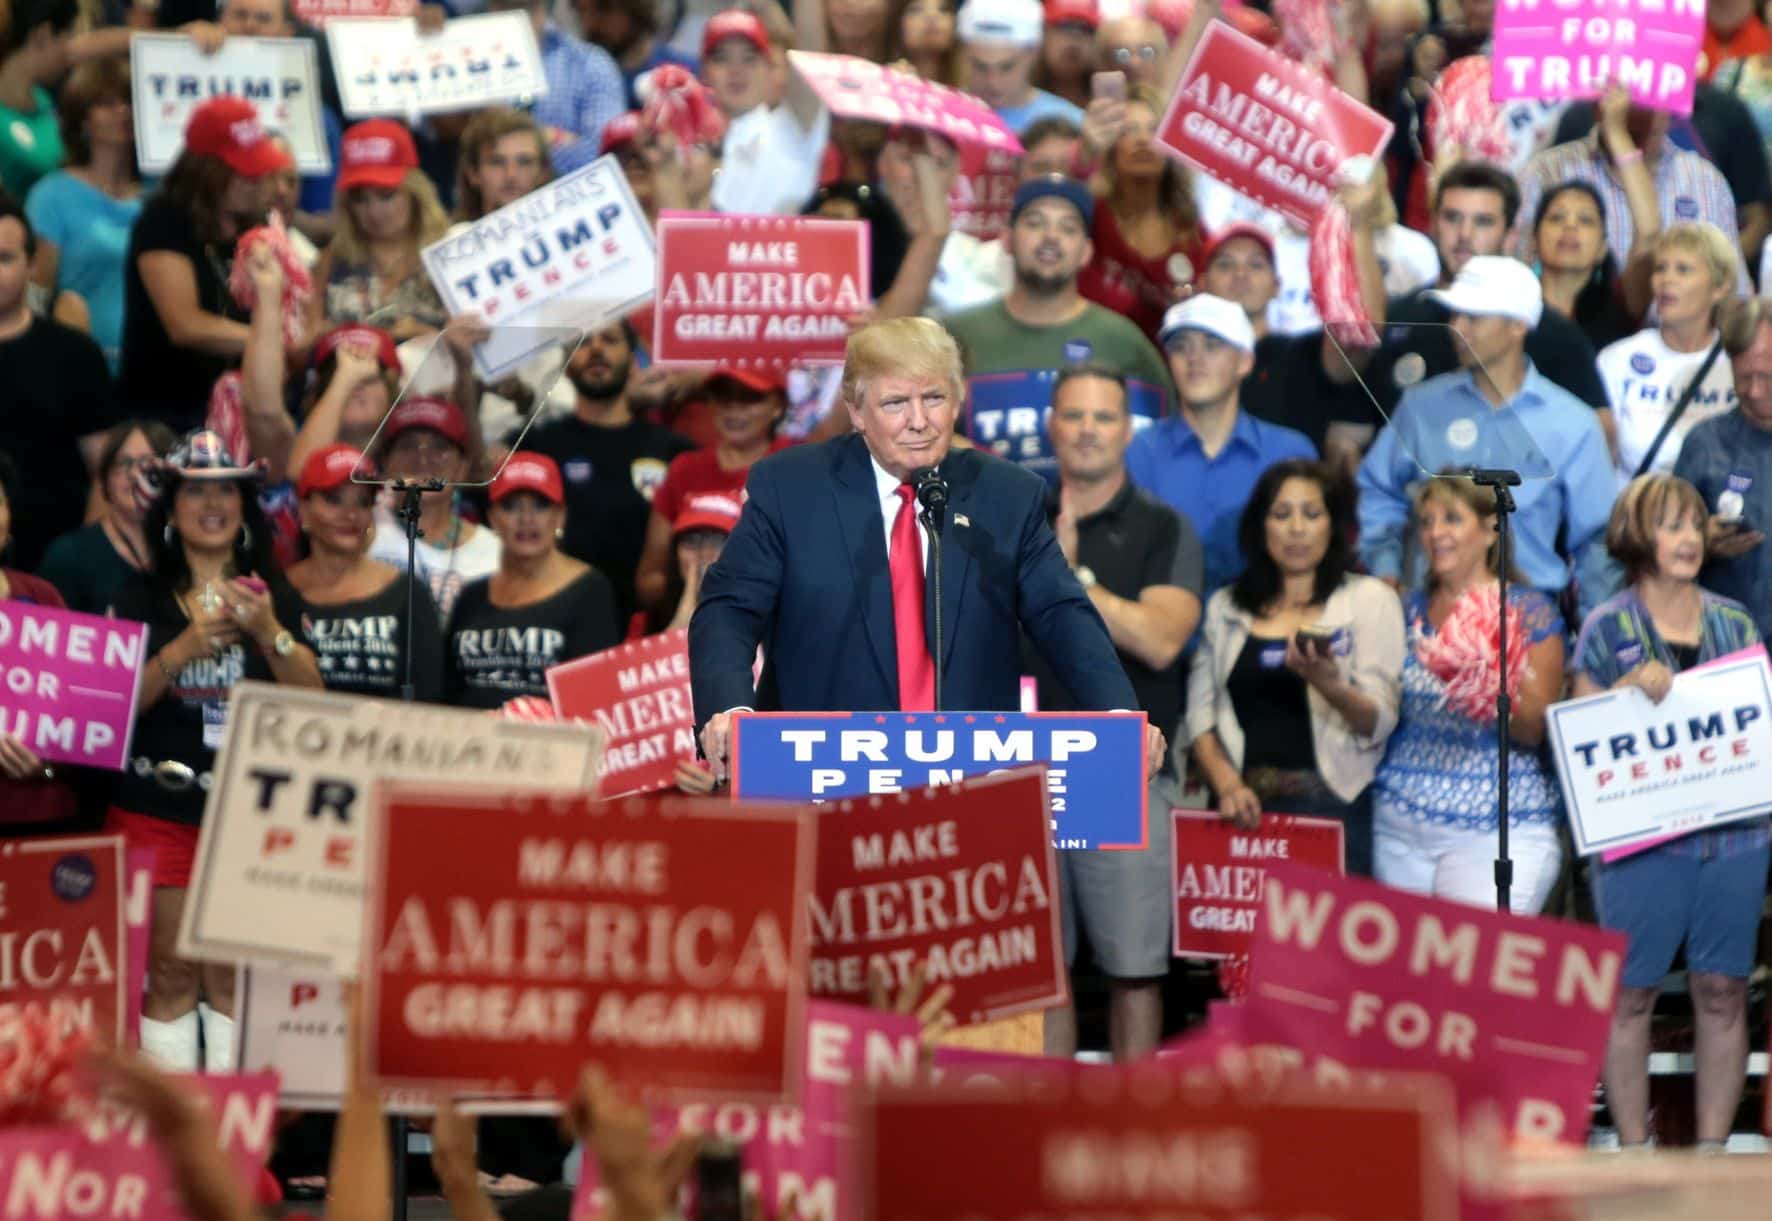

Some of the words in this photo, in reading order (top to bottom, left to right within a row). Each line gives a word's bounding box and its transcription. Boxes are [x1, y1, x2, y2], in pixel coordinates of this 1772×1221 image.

[1563, 17, 1637, 46] FOR
[149, 74, 304, 98] TRUMP
[1254, 71, 1323, 122] MAKE
[1505, 54, 1687, 98] TRUMP
[1183, 72, 1337, 174] AMERIC
[1183, 111, 1259, 166] GREAT
[457, 202, 622, 300] TRUMP
[484, 238, 618, 315] PENCE
[728, 241, 799, 264] MAKE
[663, 271, 862, 308] AMERICA
[674, 312, 761, 339] GREAT
[0, 664, 60, 700] OR
[618, 653, 689, 693] MAKE
[0, 704, 116, 757] UMP
[781, 730, 1097, 762] TRUMP
[1573, 704, 1762, 768] TRUMP
[811, 769, 1067, 794] PENE
[1597, 738, 1750, 786] PENCE
[518, 836, 670, 893] MAKE
[852, 820, 960, 871] MAKE
[1230, 836, 1289, 858] MAKE
[806, 854, 1050, 945] MERICA
[1189, 906, 1257, 932] GREAT
[378, 893, 790, 988] AMERICA
[811, 949, 915, 992] REAT
[926, 925, 1037, 984] AGAIN
[1265, 877, 1621, 1012] WOMEN
[403, 981, 582, 1043] GREAT
[588, 990, 766, 1050] AGAIN
[1346, 990, 1477, 1061] FOR
